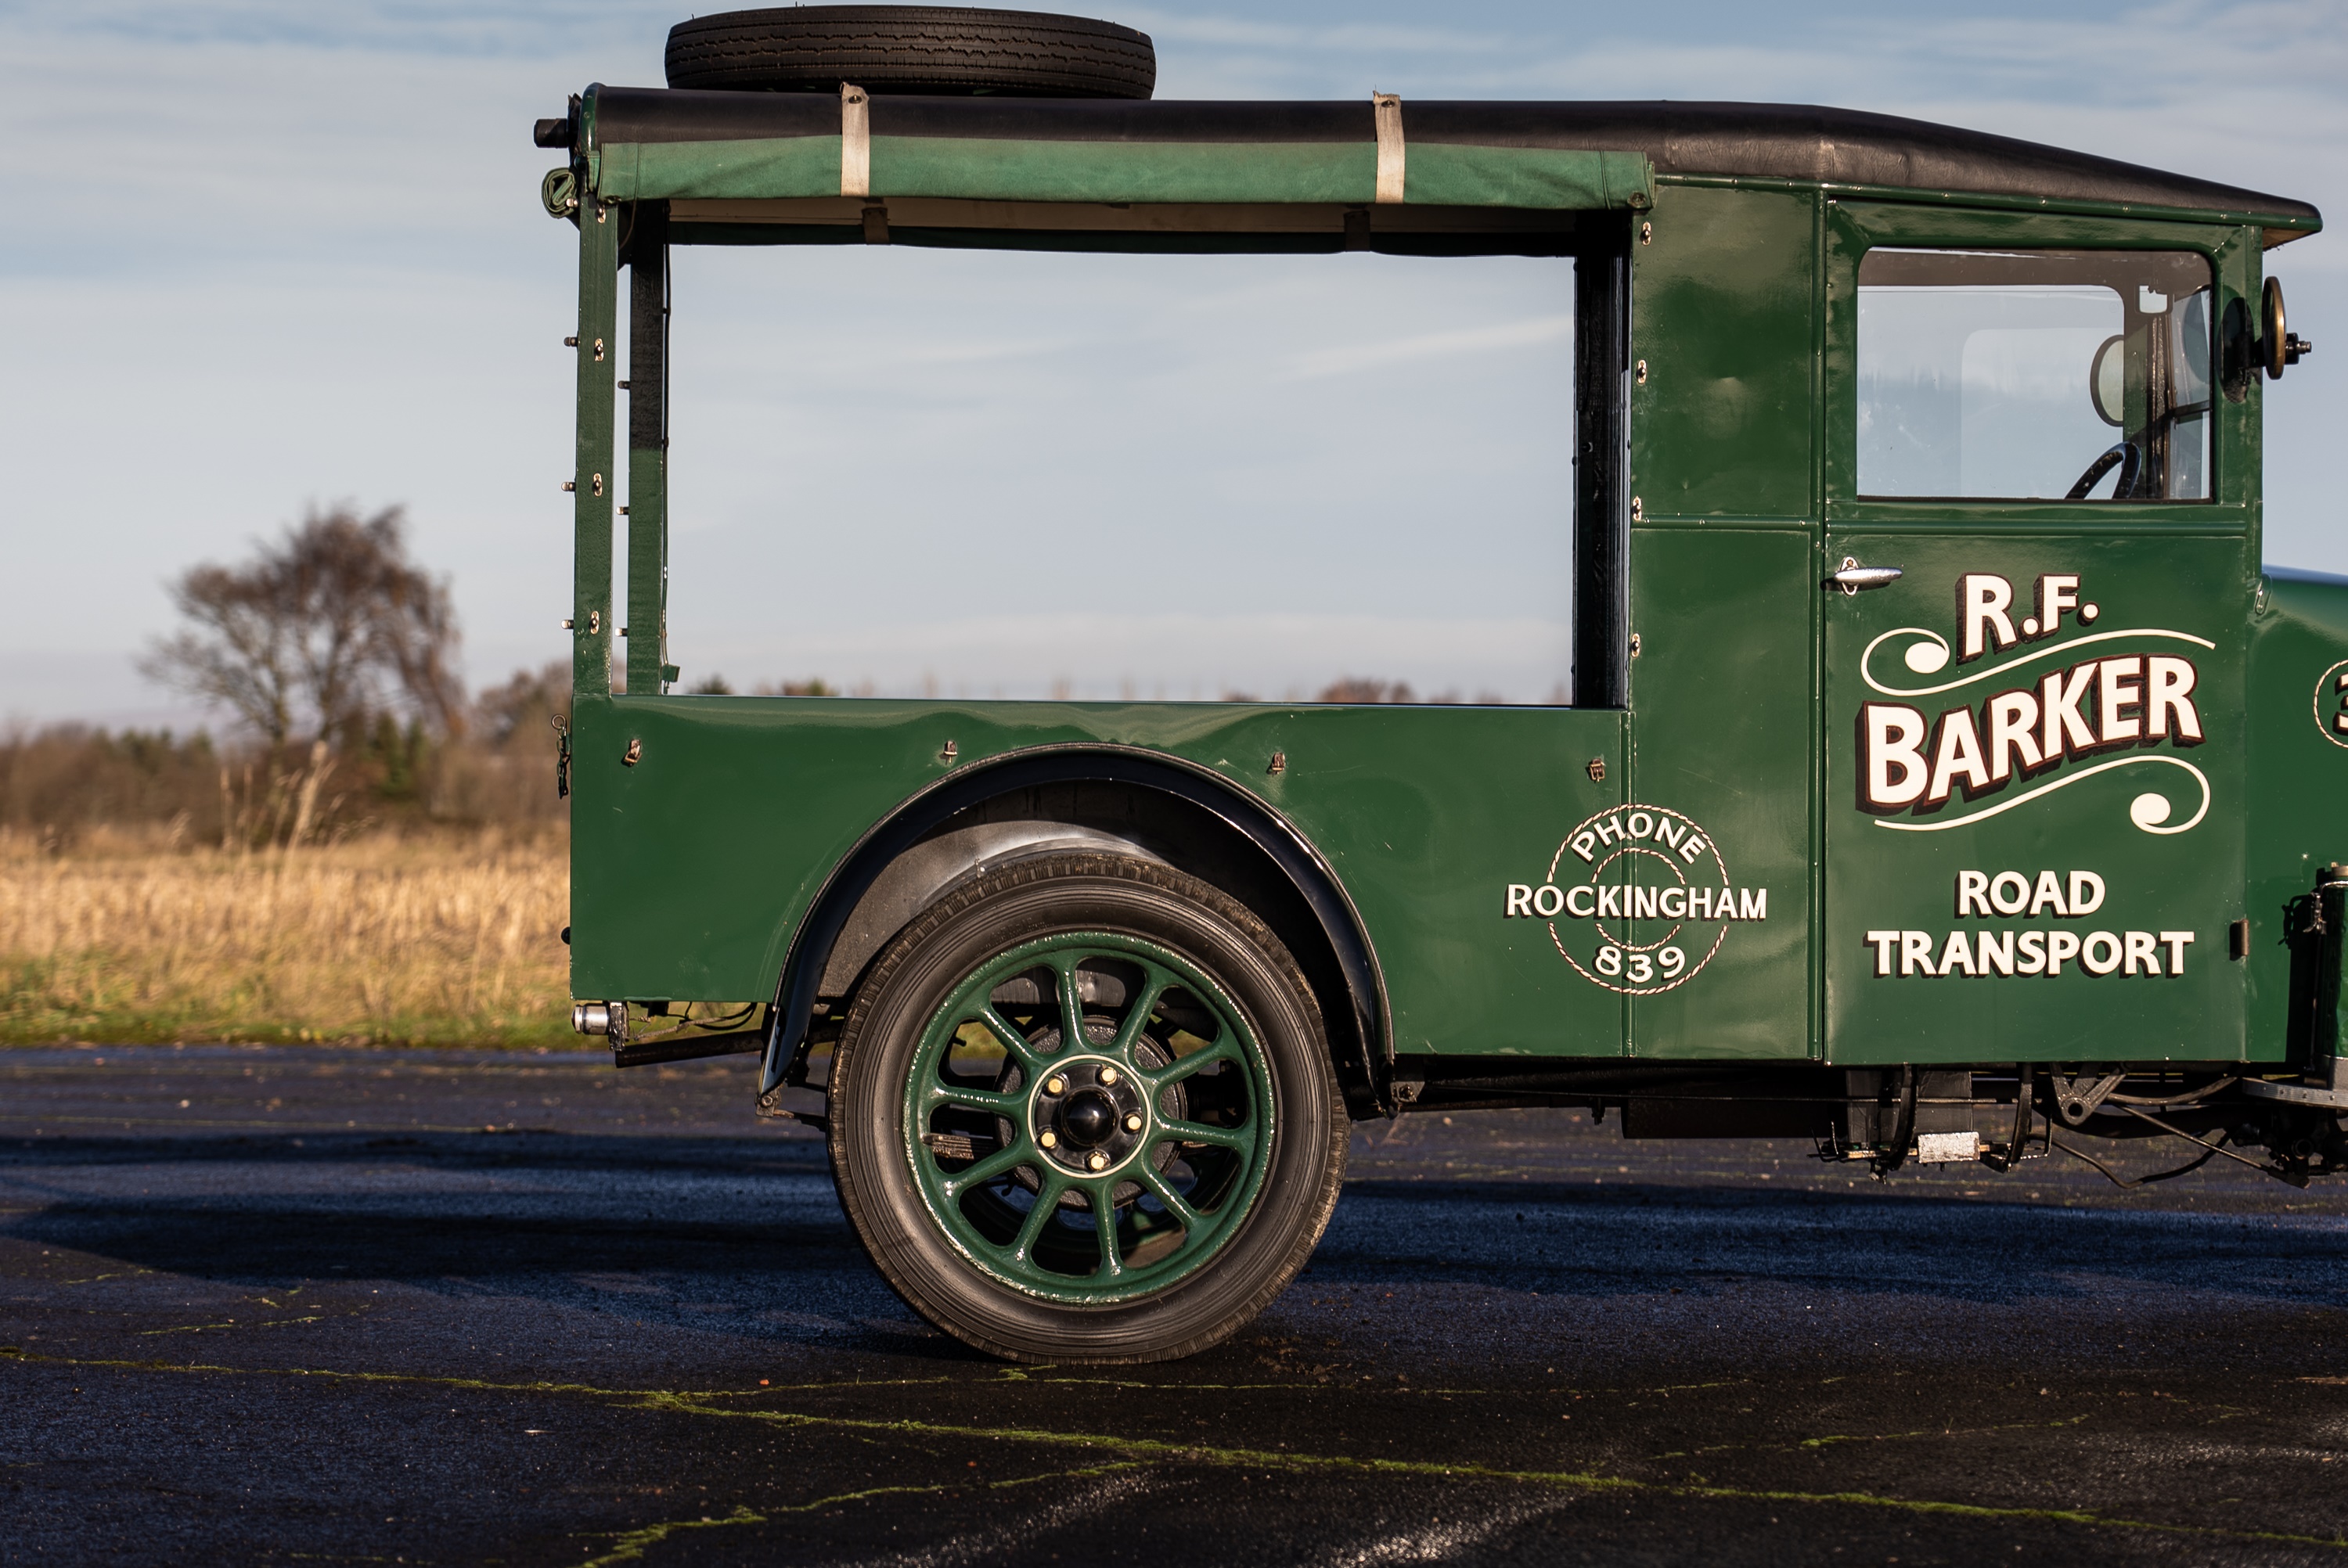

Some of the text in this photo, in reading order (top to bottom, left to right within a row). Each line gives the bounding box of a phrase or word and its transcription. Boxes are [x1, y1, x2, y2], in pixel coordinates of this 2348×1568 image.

[1961, 574, 2100, 659] R.F.
[1863, 655, 2203, 807] BARKER
[1570, 811, 1707, 865] PHONE
[1507, 883, 1768, 920] ROCKINGHAM
[1957, 869, 2106, 915] ROAD
[1594, 944, 1687, 984] 839
[1866, 930, 2195, 975] TRANSPORT
